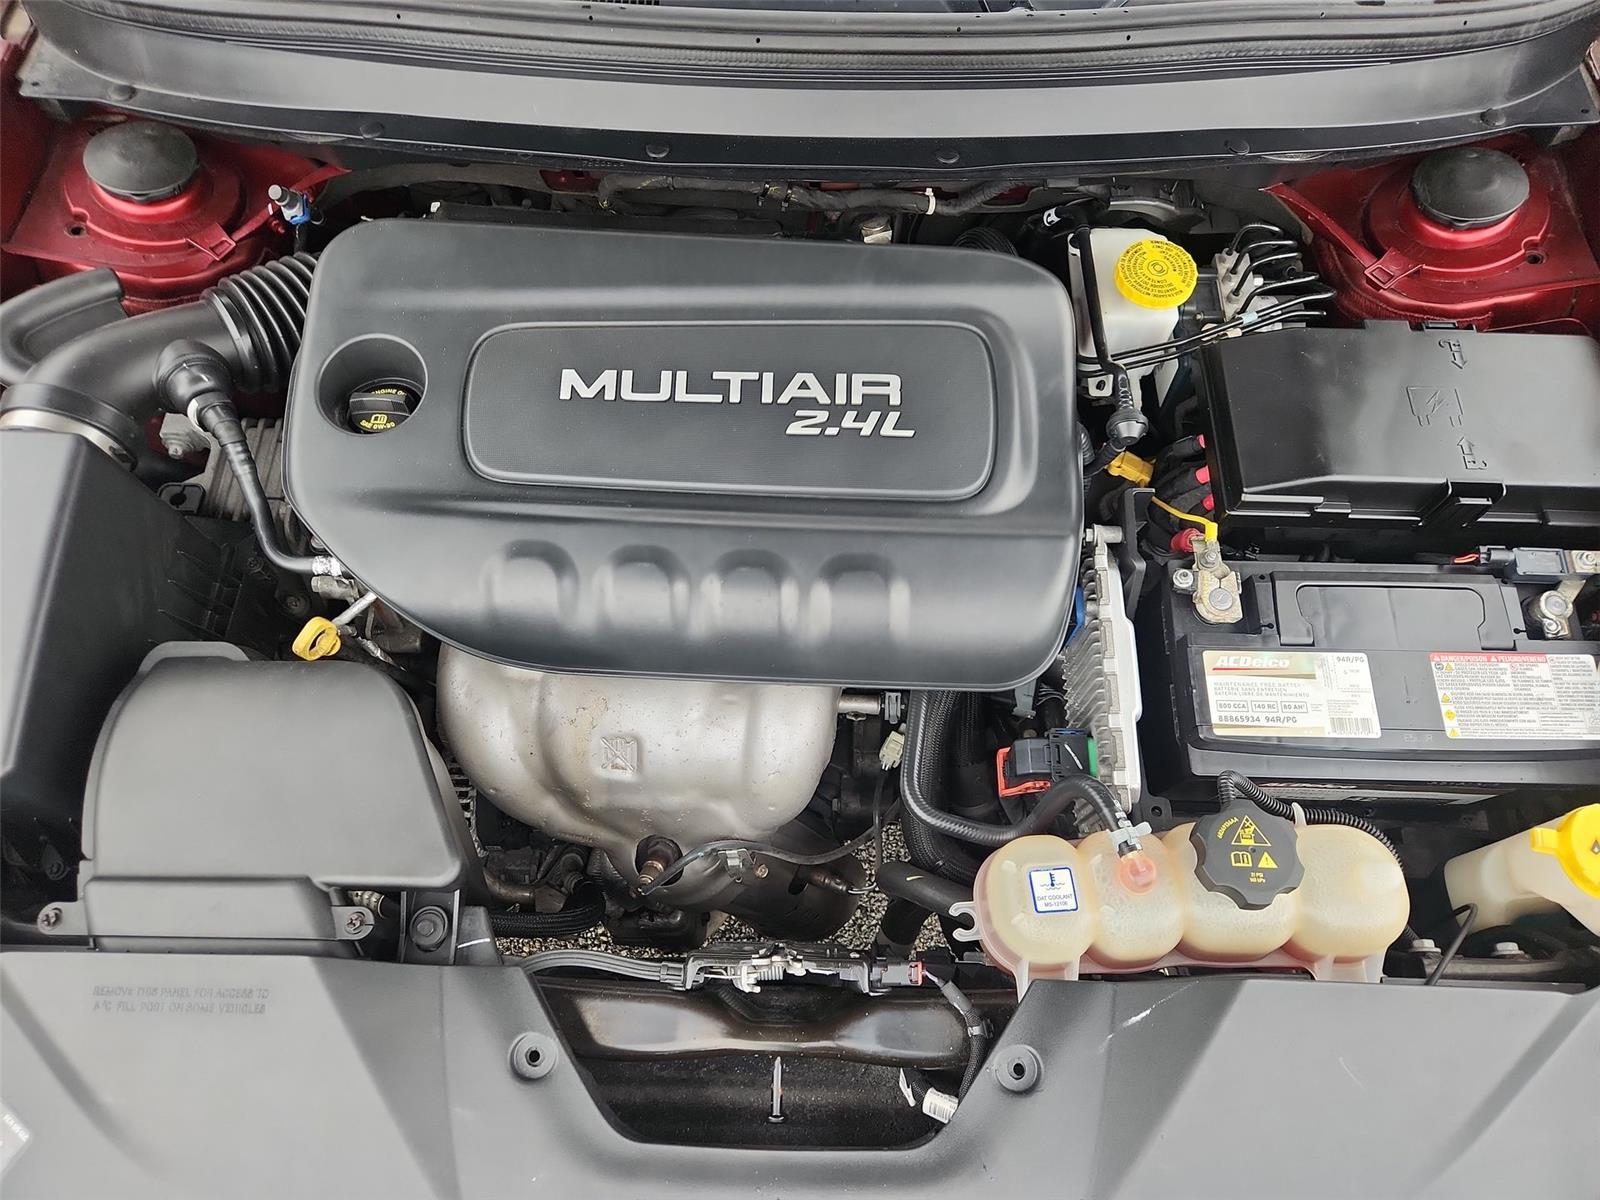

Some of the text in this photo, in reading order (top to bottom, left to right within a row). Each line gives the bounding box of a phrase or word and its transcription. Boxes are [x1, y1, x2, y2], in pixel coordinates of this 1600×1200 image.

[559, 368, 902, 406] MULTIAIR
[784, 410, 916, 438] 2.4L
[1215, 655, 1291, 668] ACDelco
[1264, 716, 1298, 724] 94R/PG
[92, 985, 132, 997] REMOVE
